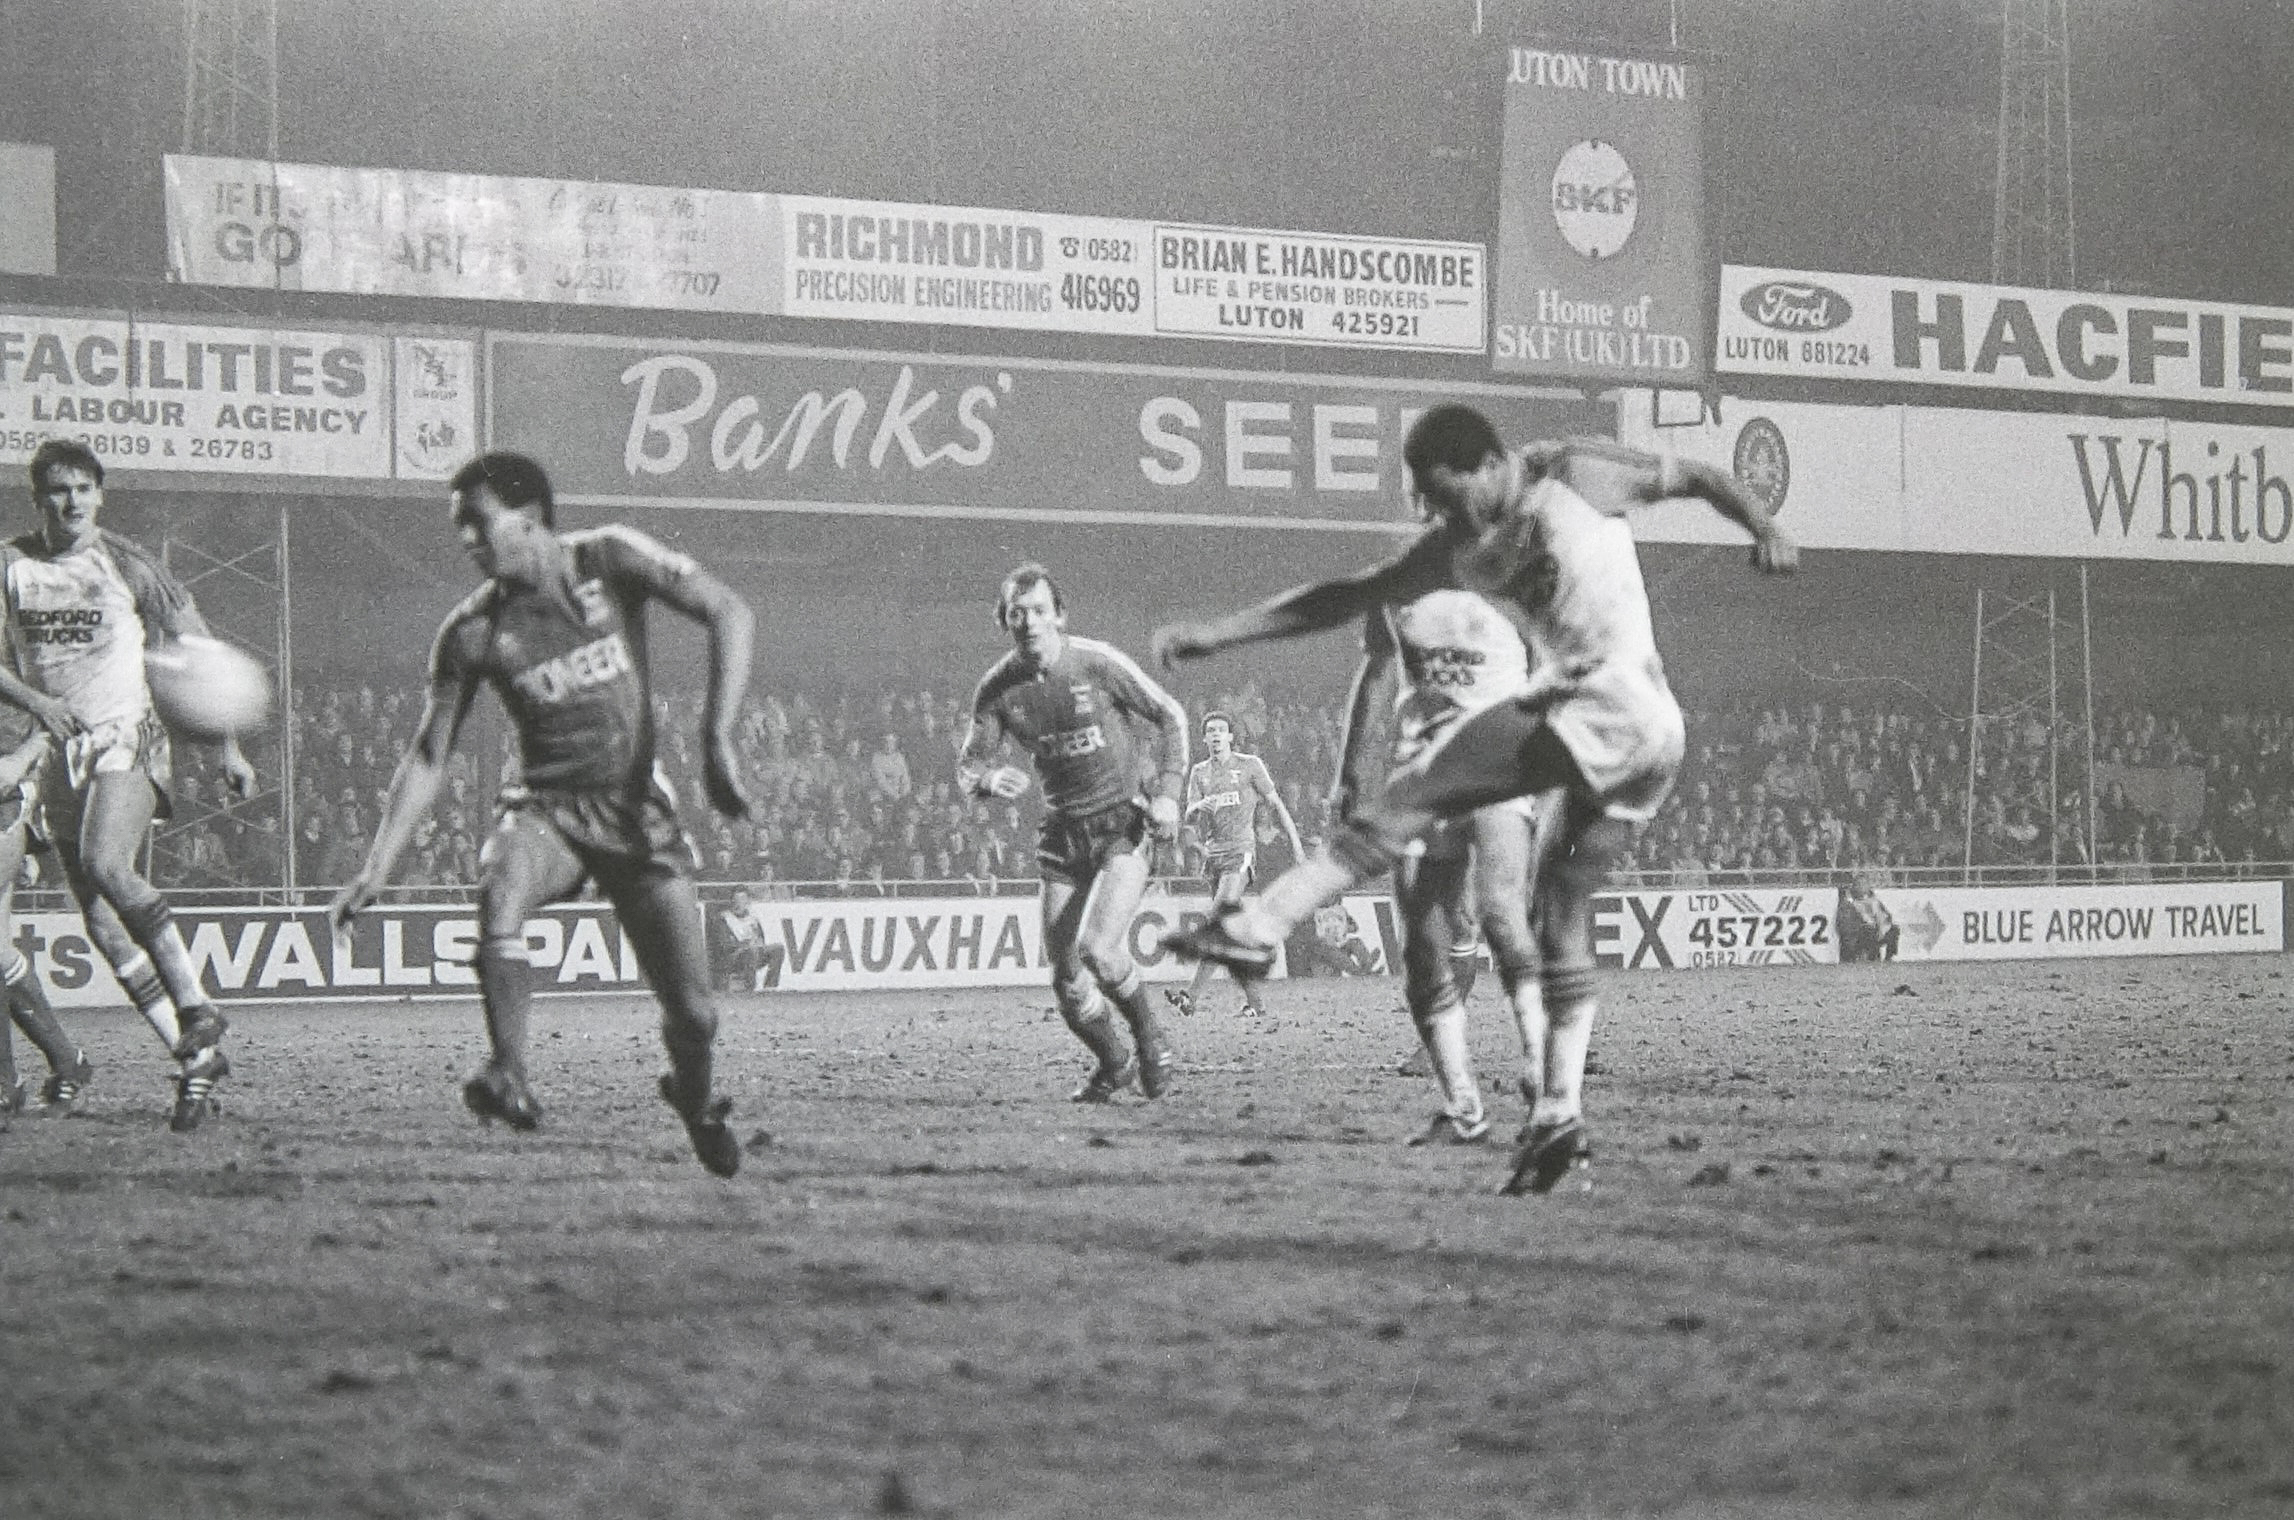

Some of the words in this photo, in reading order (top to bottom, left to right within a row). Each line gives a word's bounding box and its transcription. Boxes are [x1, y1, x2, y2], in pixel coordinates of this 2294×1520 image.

[1600, 57, 1686, 99] TOWN
[215, 221, 302, 267] GO
[796, 212, 1044, 272] RICHMOND
[1161, 236, 1247, 274] BRIAN
[796, 268, 906, 305] PRECISION
[914, 275, 1051, 313] ENGINEERING
[1060, 273, 1141, 313] 416969
[1172, 275, 1218, 298] LIFE
[1249, 281, 1336, 305] PENSION
[1343, 287, 1430, 310] BROKERS
[1537, 290, 1613, 327] Home
[1623, 295, 1652, 329] of
[1757, 285, 1831, 328] Ford
[1218, 303, 1304, 331] LUTON
[1331, 311, 1419, 337] 425921
[1497, 324, 1558, 360] SKF
[1725, 339, 1790, 362] LUTON
[1891, 290, 2293, 393] HACFIE
[0, 331, 367, 399] FACILITIES
[32, 394, 185, 428] LABOUR
[215, 403, 368, 434] AGENCY
[163, 440, 177, 457] &
[190, 438, 273, 461] 26783
[1139, 396, 1413, 492] SEE
[2066, 433, 2293, 544] Whitb
[1688, 894, 1720, 911] LTD
[1964, 910, 2035, 944] BLUE
[2046, 907, 2156, 943] ARROW
[2164, 902, 2266, 938] TRAVEL
[781, 913, 1050, 974] VAUXHA
[1688, 914, 1829, 948] 457222
